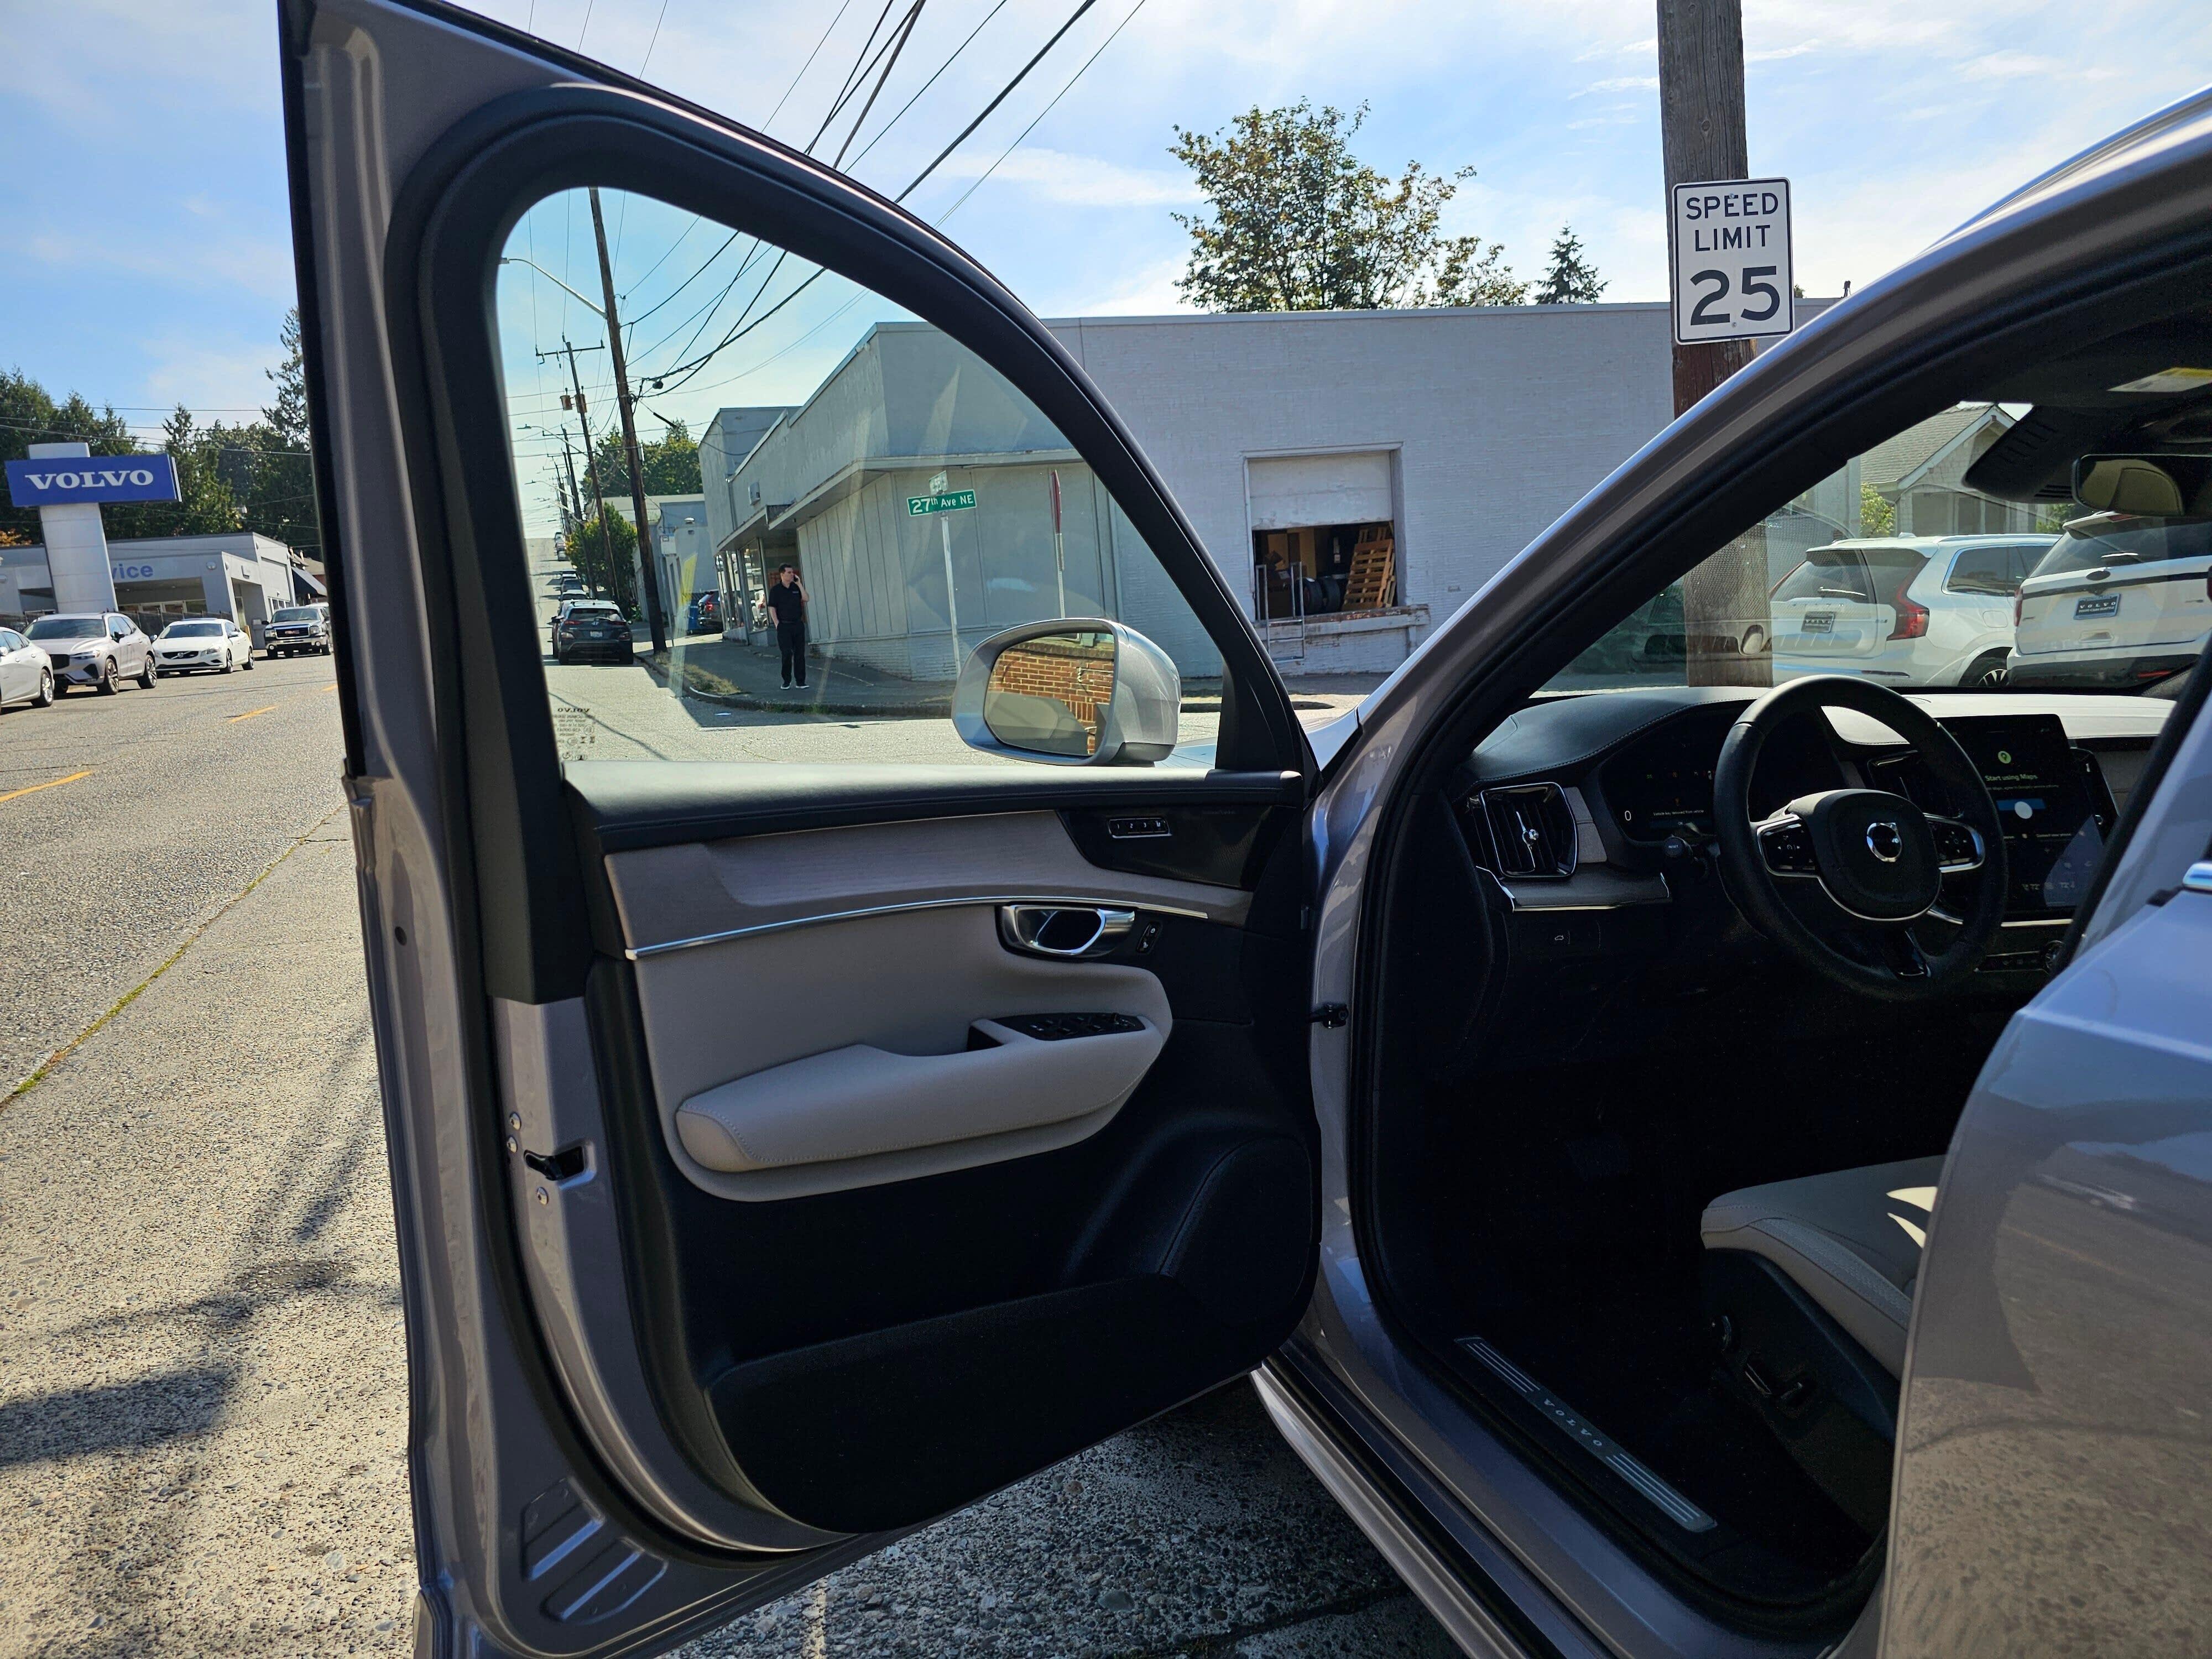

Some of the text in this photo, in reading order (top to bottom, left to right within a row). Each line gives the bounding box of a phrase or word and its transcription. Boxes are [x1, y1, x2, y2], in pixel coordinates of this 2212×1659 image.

[1686, 192, 1778, 220] SPEED
[1695, 225, 1771, 252] LIMIT
[1690, 265, 1780, 326] 25
[25, 469, 154, 489] VOLVO
[911, 494, 974, 513] 27th Ave NE
[1624, 810, 1631, 821] 0
[1543, 1398, 1603, 1447] VOLVO
